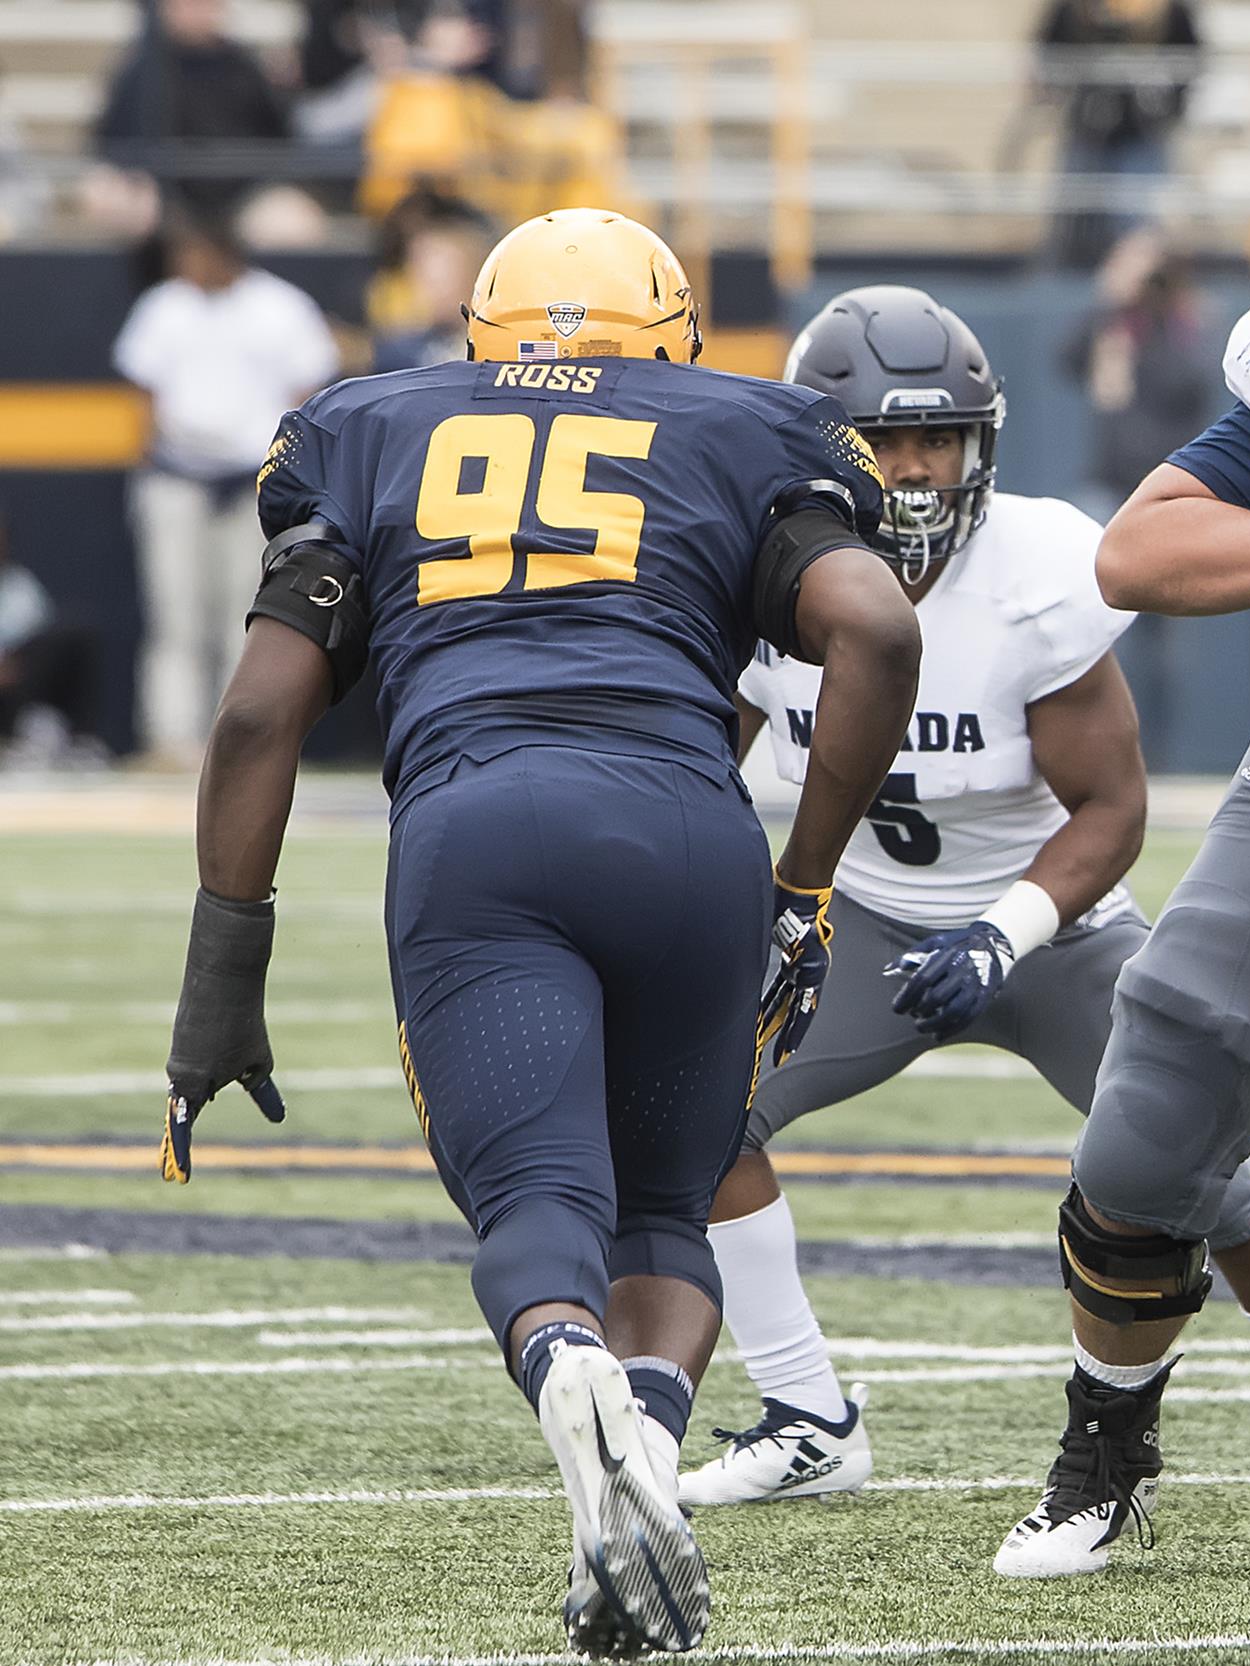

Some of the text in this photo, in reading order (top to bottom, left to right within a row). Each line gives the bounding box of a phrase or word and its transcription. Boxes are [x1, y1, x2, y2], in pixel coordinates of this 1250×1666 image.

[551, 313, 582, 323] MAC
[494, 364, 603, 394] ROSS
[416, 414, 658, 607] 95
[785, 707, 984, 753] NDA
[864, 772, 942, 866] 5
